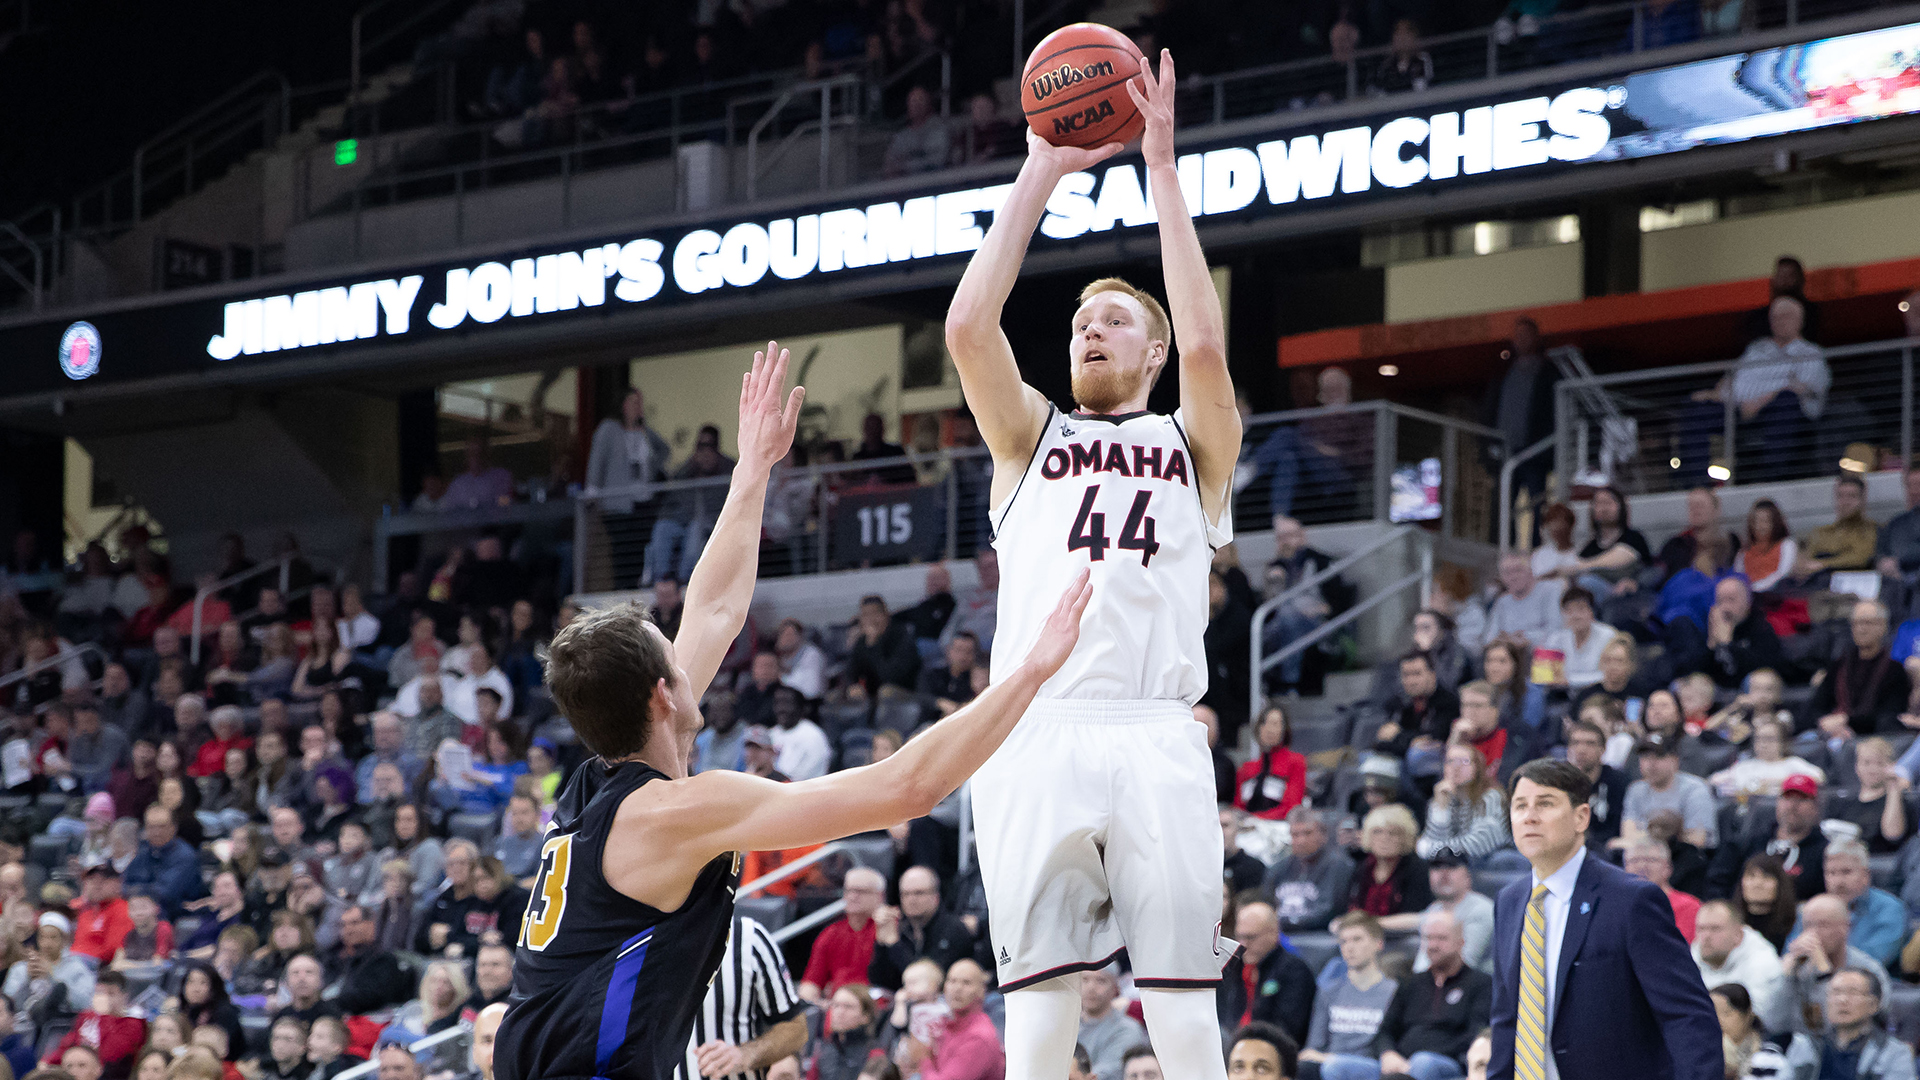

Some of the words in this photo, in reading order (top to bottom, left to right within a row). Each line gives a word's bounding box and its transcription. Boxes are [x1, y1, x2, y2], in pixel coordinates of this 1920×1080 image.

[1031, 60, 1114, 102] Wilson
[1052, 99, 1116, 134] NCAA
[206, 274, 425, 361] JIMMY
[427, 238, 665, 330] JOHN'S
[1041, 439, 1189, 488] OMAHA
[857, 502, 912, 547] 115
[1067, 484, 1160, 569] 44
